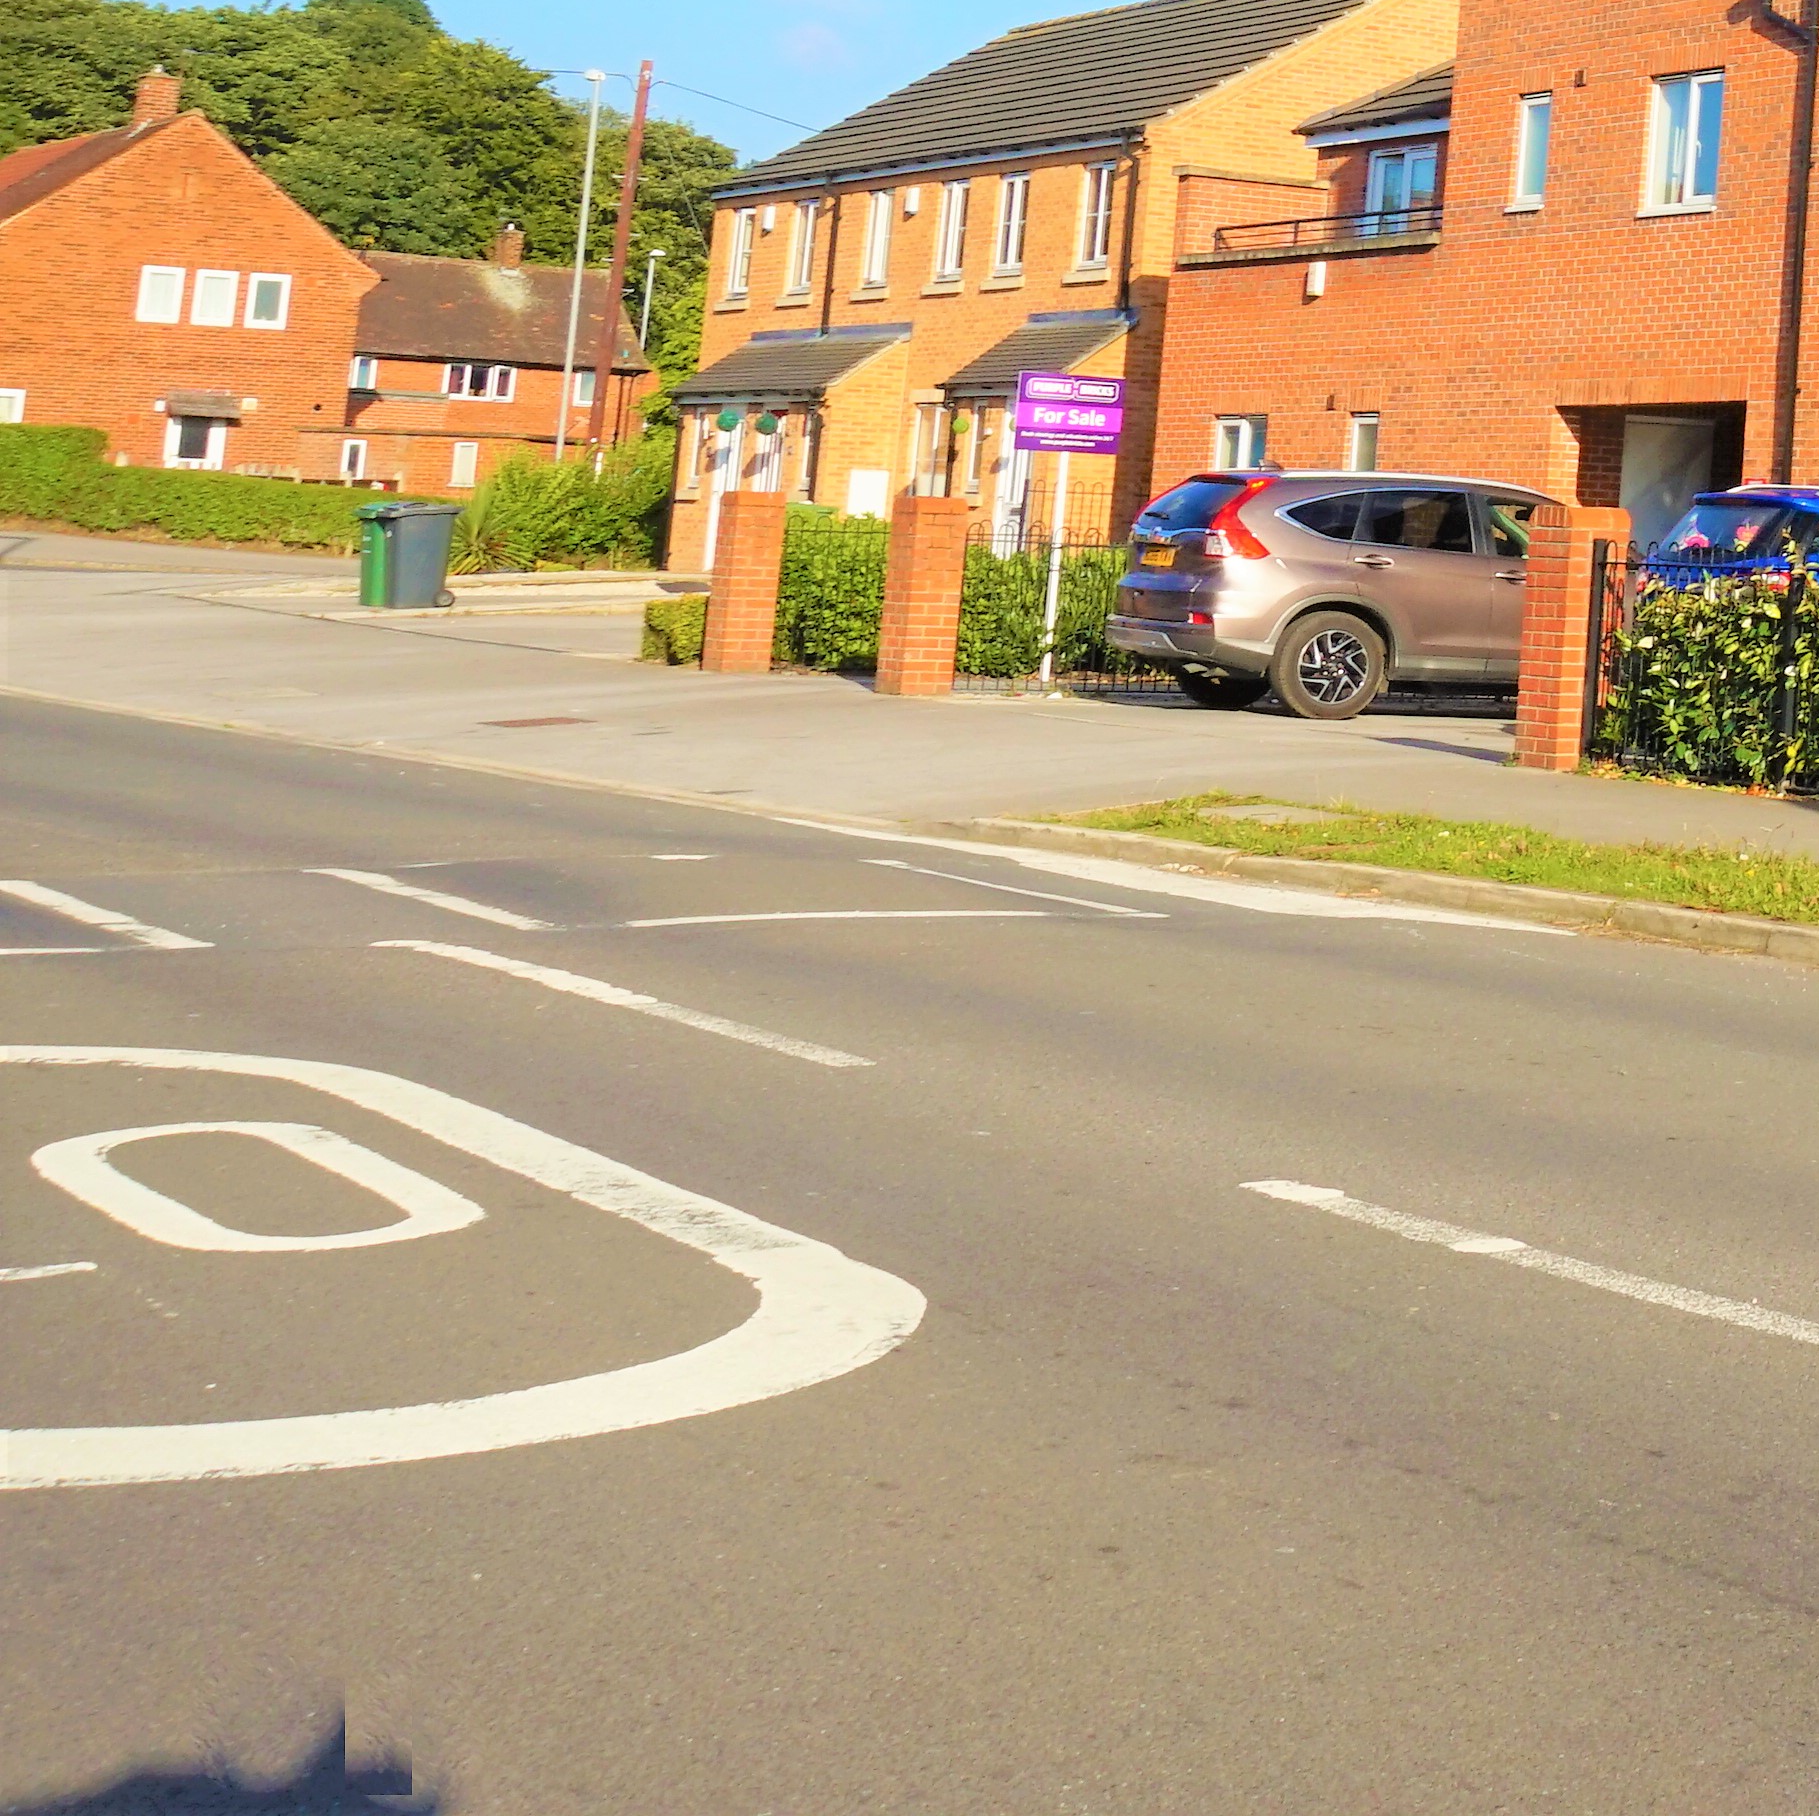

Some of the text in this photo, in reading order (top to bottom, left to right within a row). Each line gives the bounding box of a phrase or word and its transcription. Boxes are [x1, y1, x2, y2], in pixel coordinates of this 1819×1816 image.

[1033, 407, 1106, 427] For Sale
[0, 1120, 487, 1282] 0
